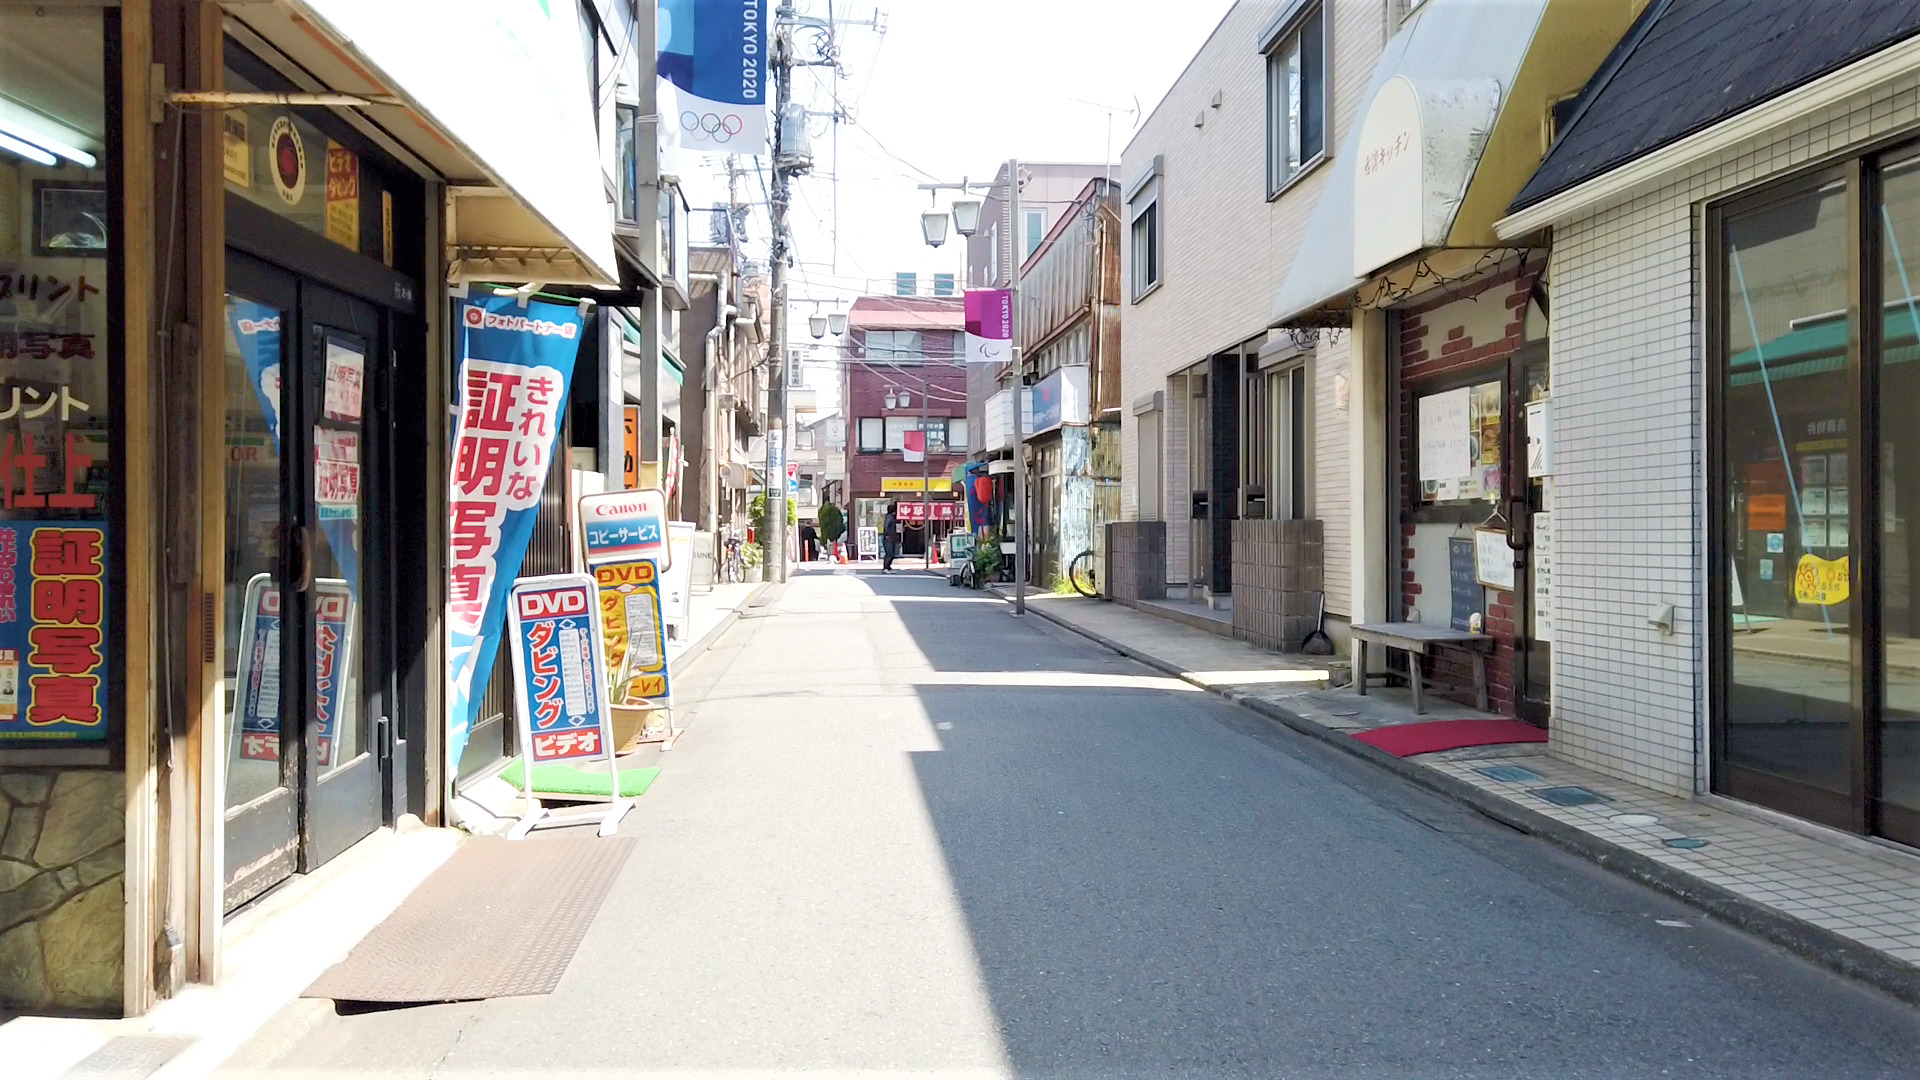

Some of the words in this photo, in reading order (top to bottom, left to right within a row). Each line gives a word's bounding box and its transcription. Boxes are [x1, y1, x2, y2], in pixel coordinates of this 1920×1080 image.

[742, 0, 757, 54] TOKYO
[742, 57, 757, 99] 2020
[1001, 295, 1009, 318] TOKYO
[488, 314, 574, 336] フォトパートナー店
[1001, 319, 1009, 337] 2020
[505, 376, 554, 500] きれいな
[0, 432, 97, 509] 仕上
[452, 368, 522, 627] 証明写真
[595, 501, 648, 516] Canon
[588, 525, 660, 546] コピーサービス
[597, 565, 652, 584] DVD
[521, 590, 586, 616] DVD
[27, 528, 103, 726] 証明写真
[603, 595, 625, 669] ダビング
[527, 620, 564, 729] ダビング
[631, 678, 662, 693] ーレイ
[534, 731, 599, 758] ビデオ
